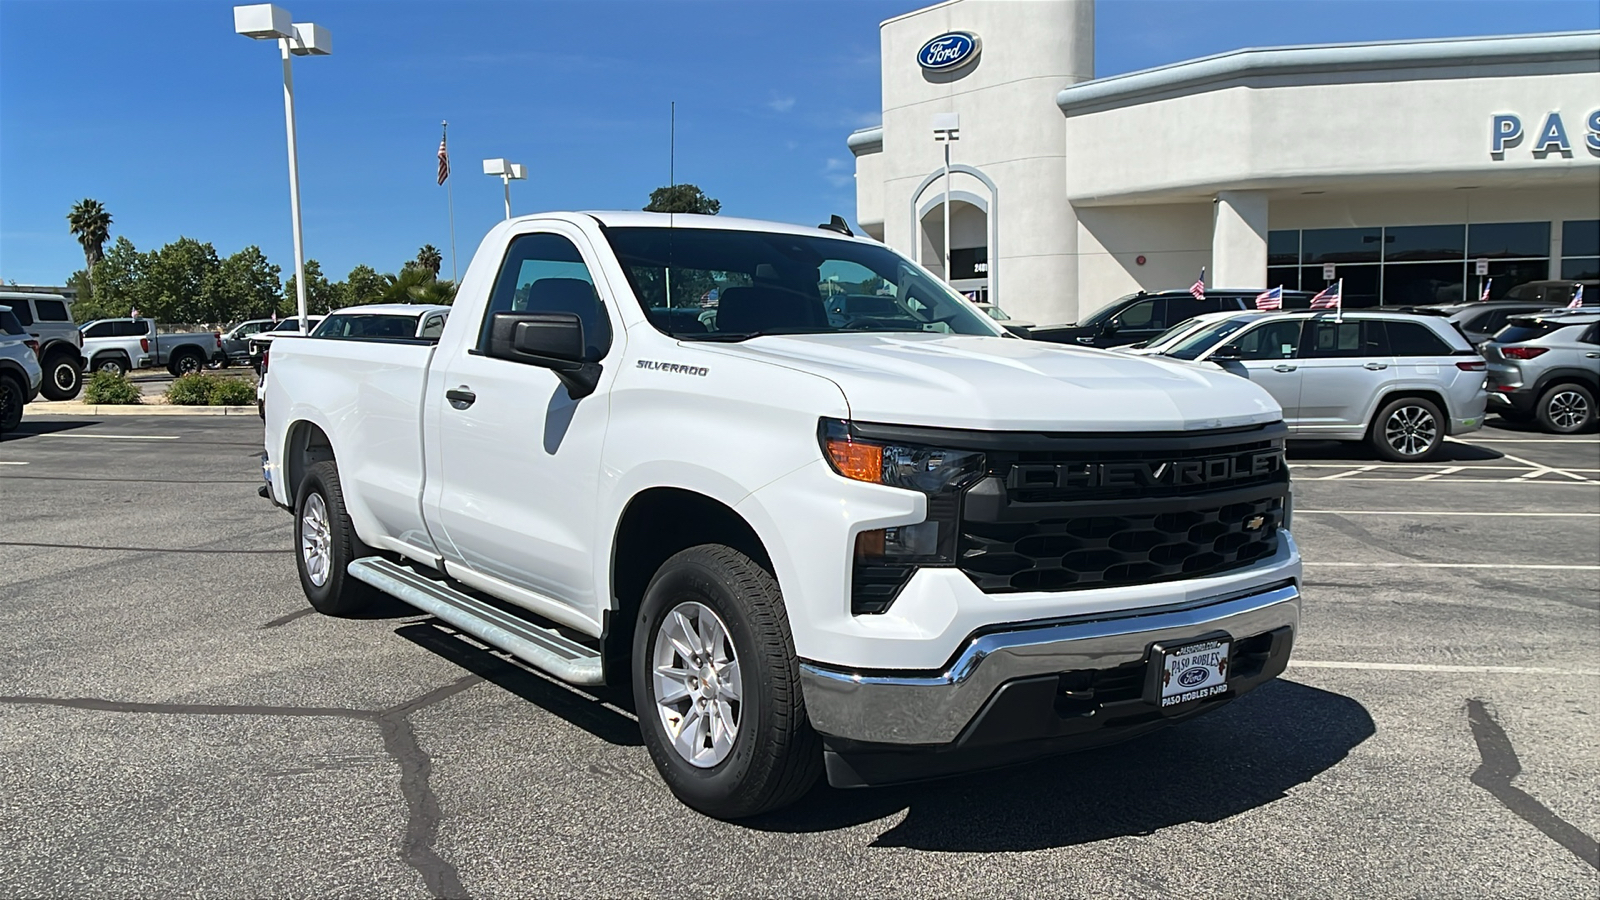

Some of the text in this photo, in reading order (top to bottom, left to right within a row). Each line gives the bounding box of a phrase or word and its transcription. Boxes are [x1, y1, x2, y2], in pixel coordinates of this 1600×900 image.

[927, 38, 962, 64] Ford
[636, 360, 709, 377] SILVERADO
[1006, 451, 1282, 488] CHEVROLET
[1171, 651, 1220, 676] PASO ROBLES
[1183, 669, 1204, 684] Ford
[1162, 684, 1228, 707] PASO ROBLES FORD
